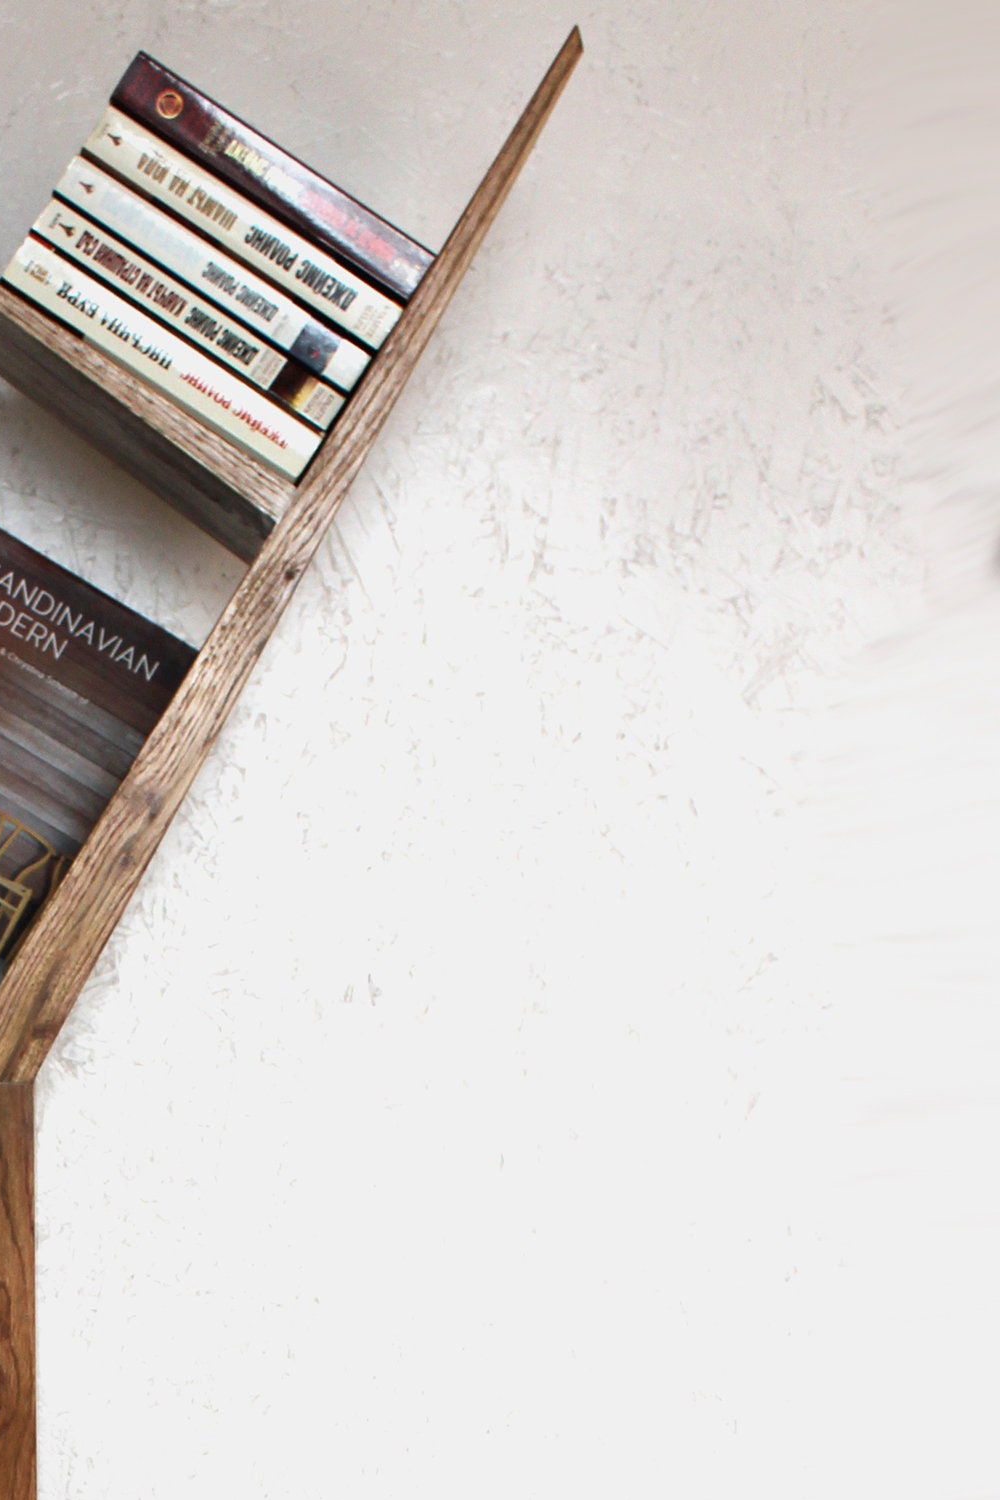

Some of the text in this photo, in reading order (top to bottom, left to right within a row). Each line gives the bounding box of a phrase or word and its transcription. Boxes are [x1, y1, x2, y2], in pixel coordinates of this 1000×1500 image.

[245, 227, 298, 272] РОЛИНС
[202, 262, 278, 322] ДЖЕЙМС РОЛИНС
[295, 260, 356, 311] ДЖЕЙМС
[185, 308, 219, 341] РОЛИНС
[217, 329, 258, 366] ДЖЕЙМС
